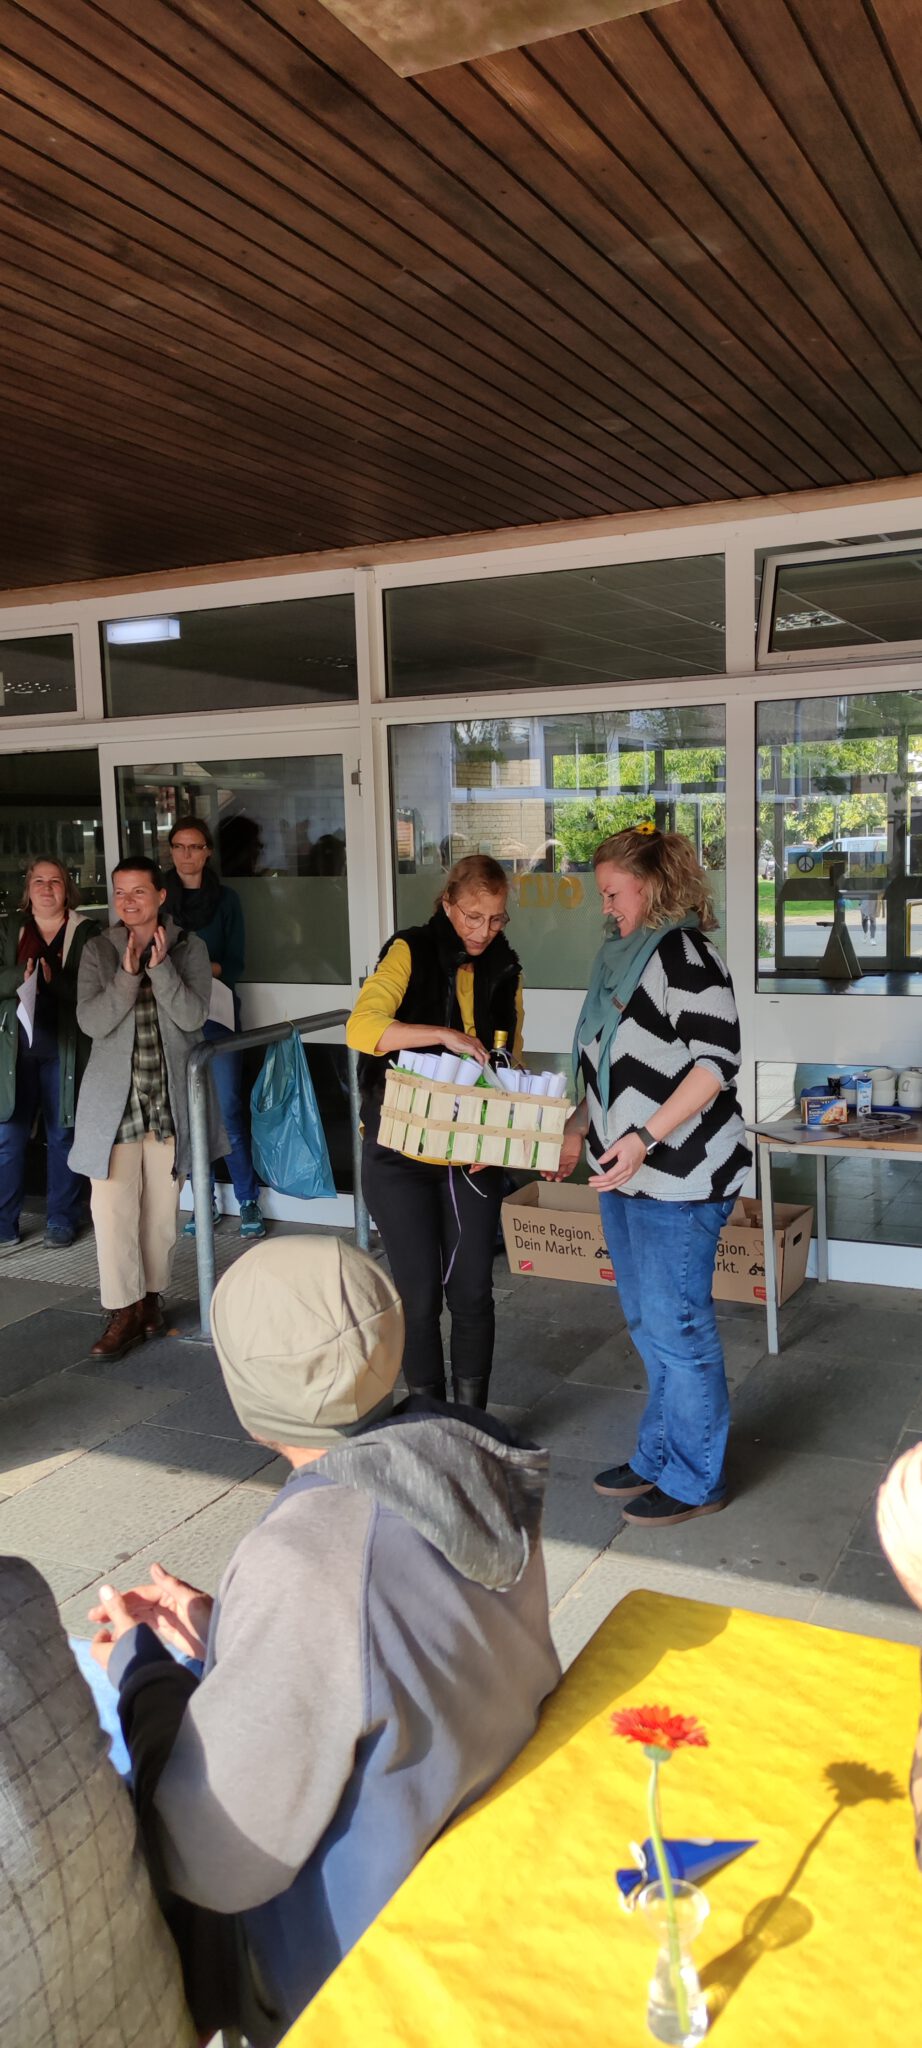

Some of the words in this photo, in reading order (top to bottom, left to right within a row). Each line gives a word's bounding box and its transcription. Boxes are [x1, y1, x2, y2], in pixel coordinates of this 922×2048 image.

[513, 1218, 546, 1235] Deine
[550, 1223, 595, 1242] Region.
[515, 1235, 541, 1251] Dein
[545, 1240, 586, 1257] Markt.
[716, 1240, 750, 1257] gion.
[716, 1258, 740, 1274] rkt.
